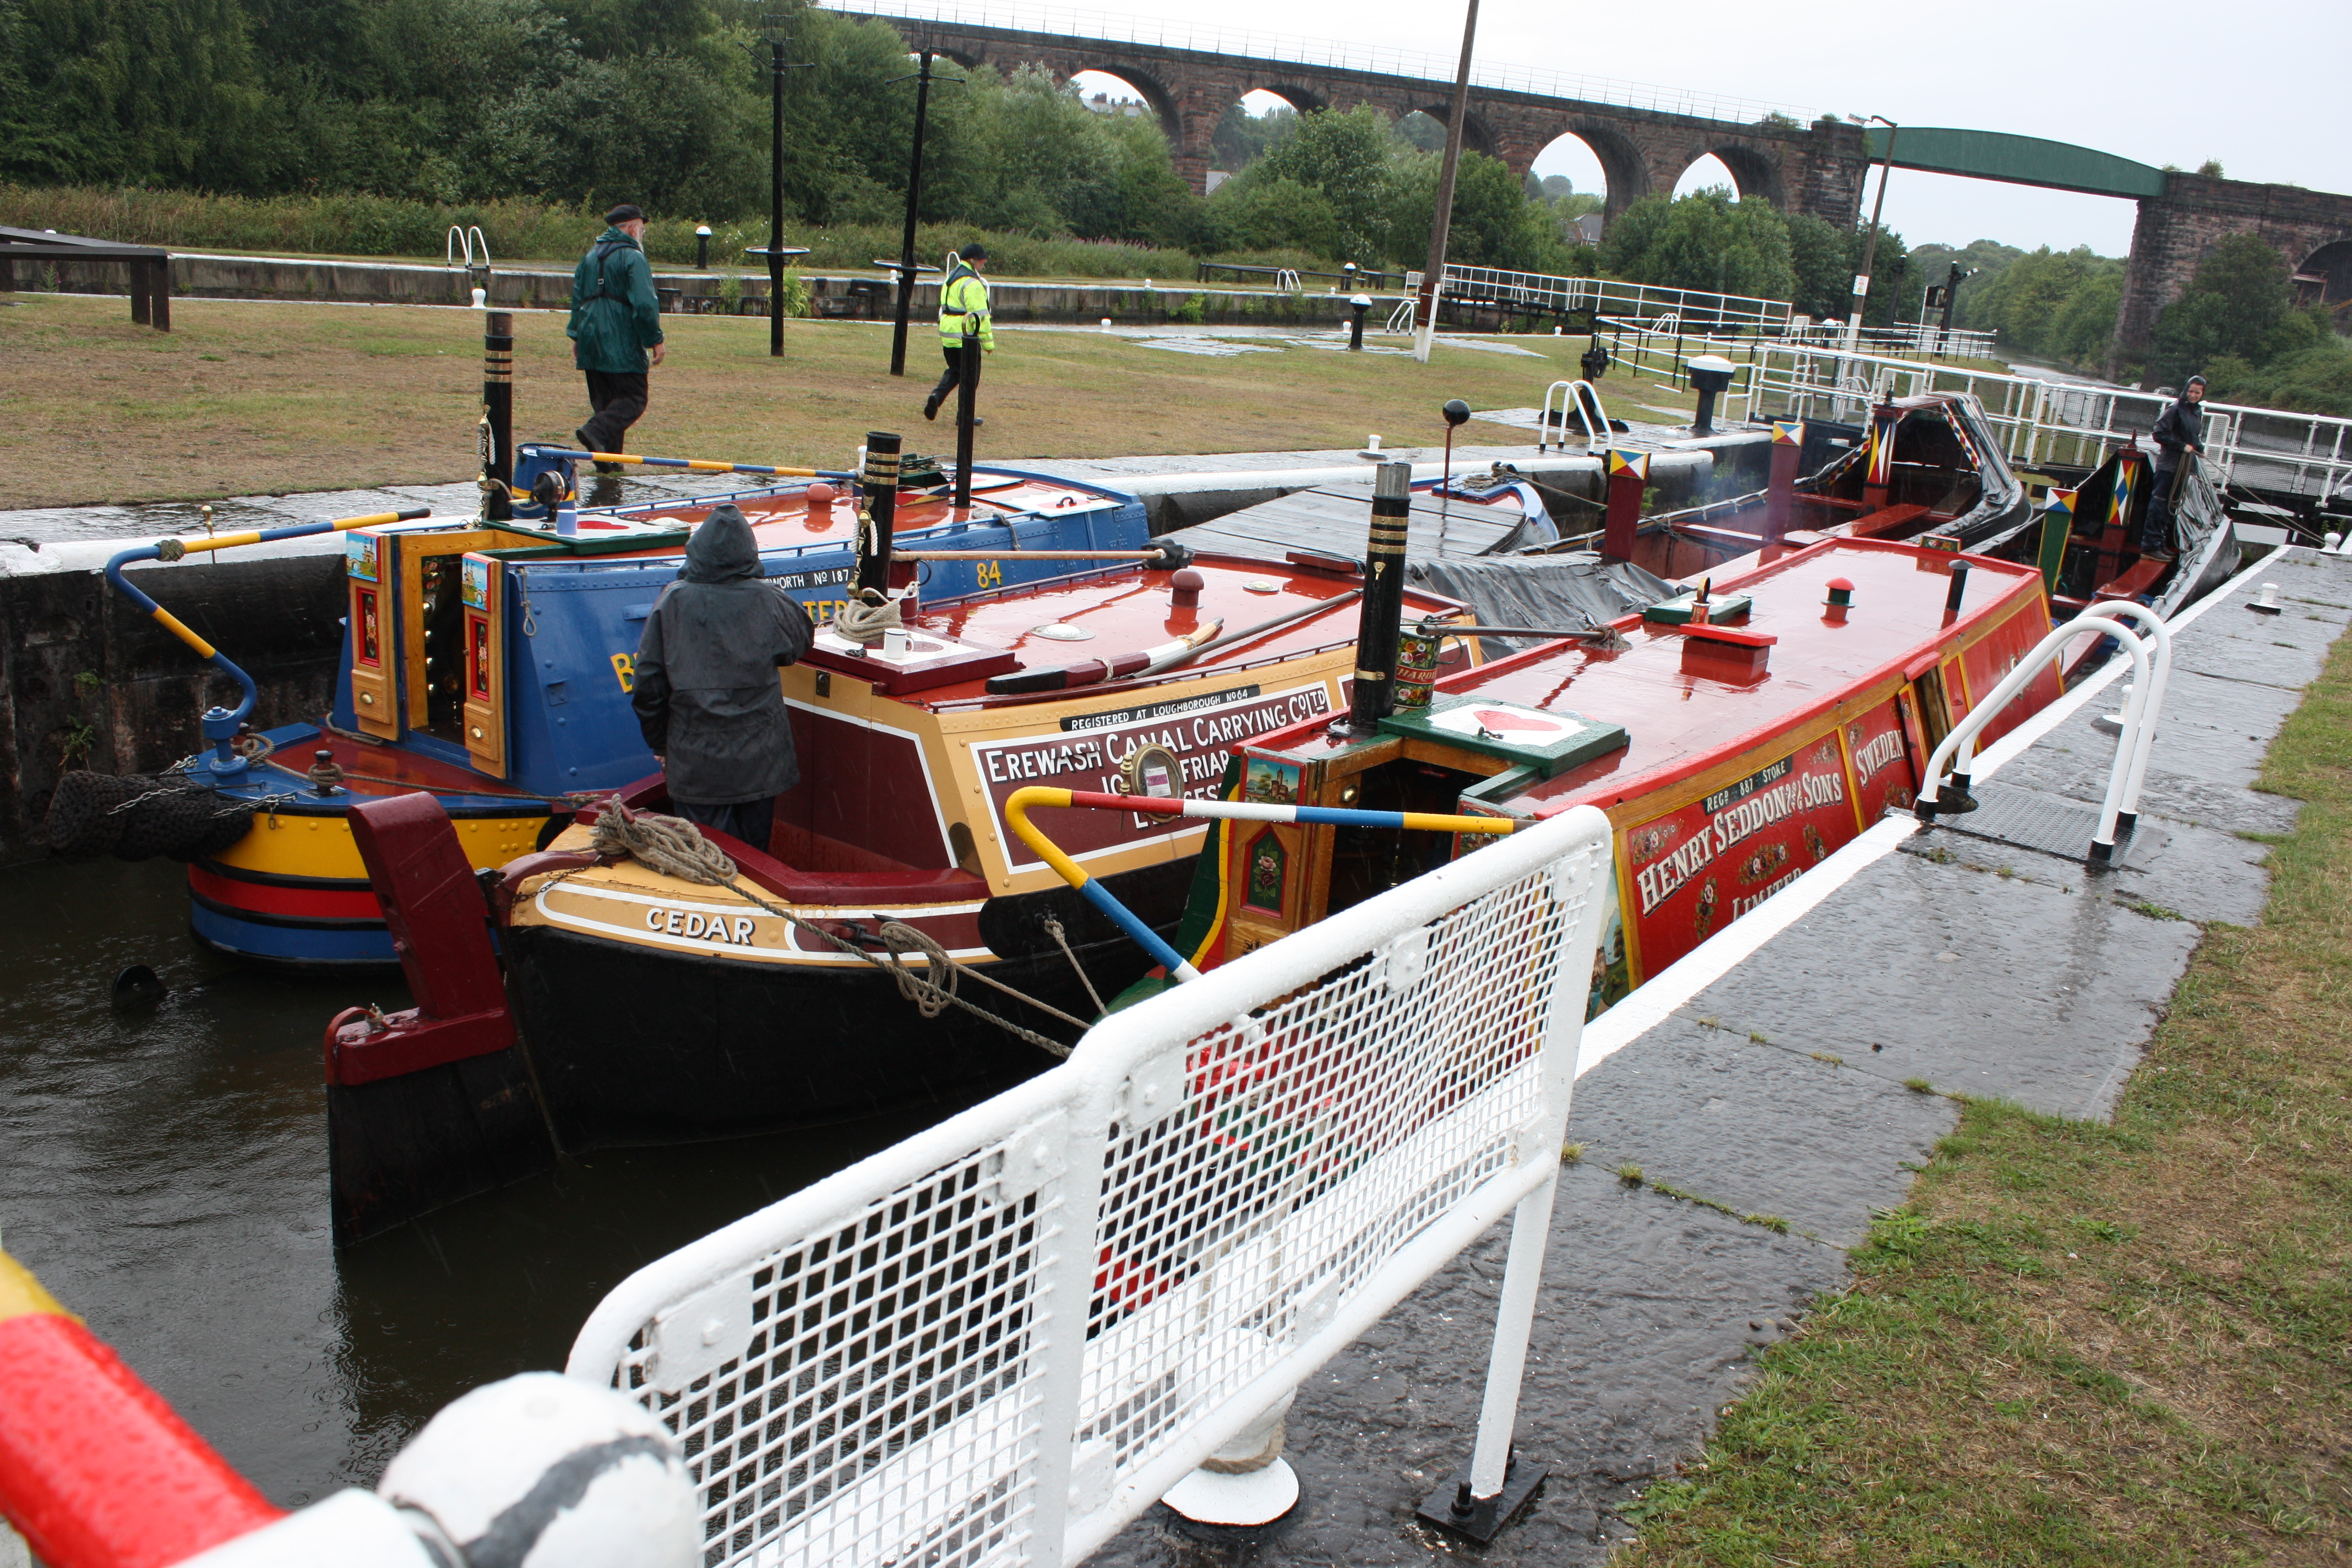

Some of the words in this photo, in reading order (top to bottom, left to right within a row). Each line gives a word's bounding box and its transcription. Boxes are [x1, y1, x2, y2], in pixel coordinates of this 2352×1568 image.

[832, 569, 848, 582] 187
[977, 560, 1001, 588] 84
[1071, 712, 1129, 730] REGISTERED
[1136, 709, 1147, 720] AT
[1153, 695, 1221, 716] LOUGHBOROUGH
[986, 741, 1103, 782] EREWASH
[1194, 704, 1287, 746] CARRYING
[1856, 729, 1905, 788] SWEDEN
[1740, 777, 1754, 796] 887
[1763, 761, 1785, 783] STOKE
[1637, 825, 1713, 918] HENRY
[1714, 785, 1788, 856] SEDDON
[1802, 771, 1843, 812] SONS
[646, 907, 755, 946] CEDAR
